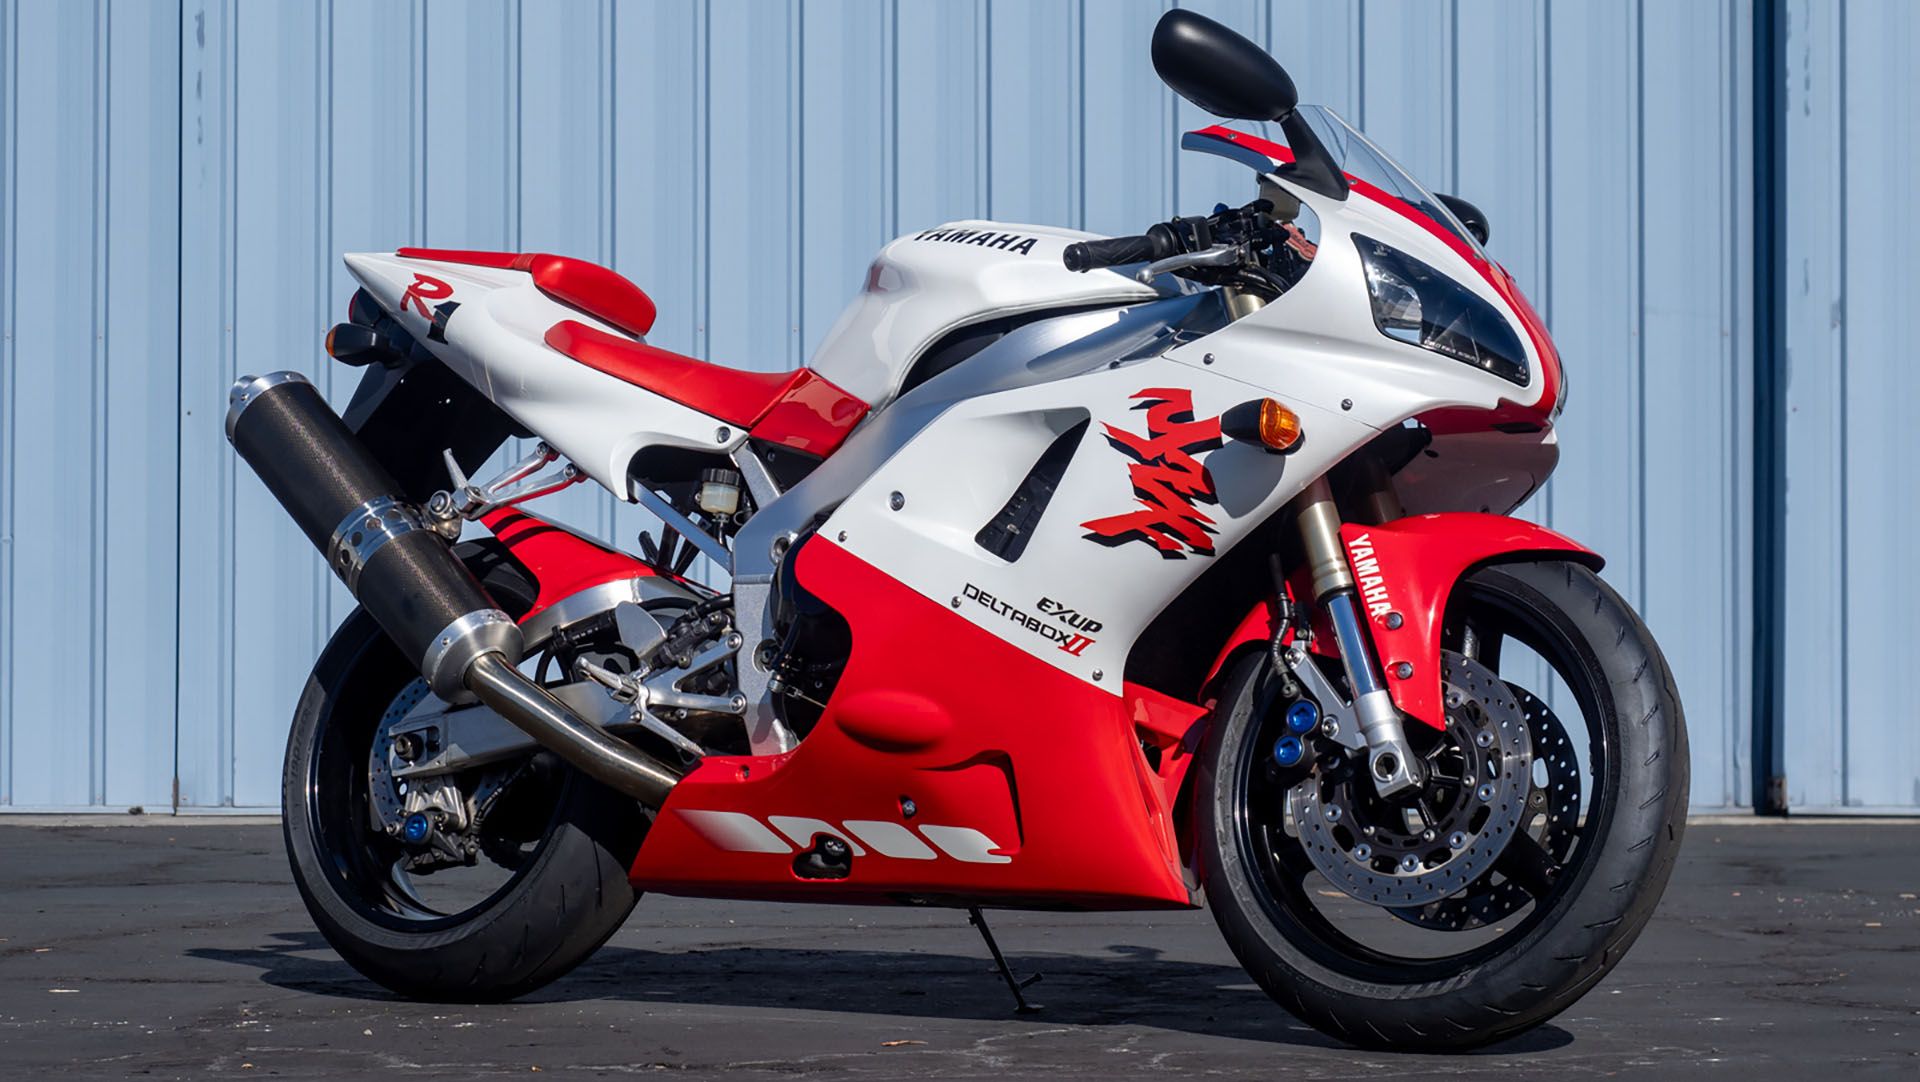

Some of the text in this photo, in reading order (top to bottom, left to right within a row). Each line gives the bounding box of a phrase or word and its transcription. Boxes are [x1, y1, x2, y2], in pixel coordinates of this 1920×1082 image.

[914, 228, 1038, 256] YAMAHA
[1348, 533, 1392, 617] YAMAHA
[1036, 596, 1103, 633] EXUP
